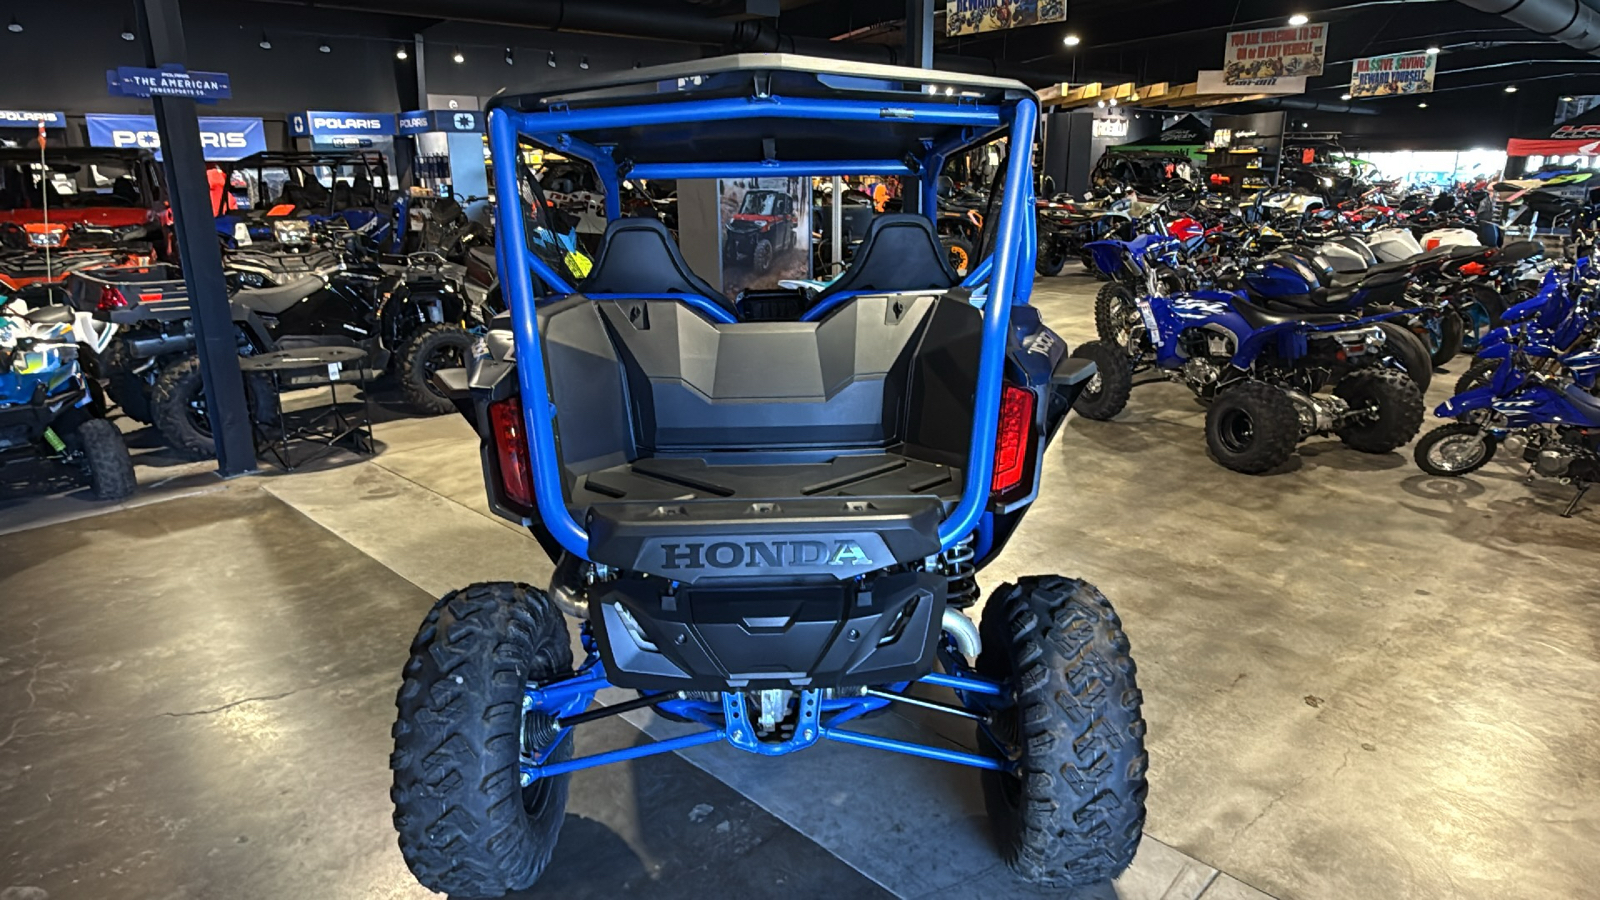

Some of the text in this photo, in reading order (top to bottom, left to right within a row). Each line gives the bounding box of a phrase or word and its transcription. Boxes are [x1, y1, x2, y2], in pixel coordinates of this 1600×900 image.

[1231, 26, 1323, 46] YOU ARE WELCOME TO SIT
[1237, 47, 1247, 60] ON
[1257, 46, 1265, 58] IN
[1266, 44, 1281, 57] ANY
[1283, 42, 1313, 56] VEHICLE
[133, 76, 219, 90] THE AMERICAN
[1360, 71, 1390, 85] REWARD
[1391, 69, 1426, 83] YOURSELF
[314, 117, 381, 129] POLARIS
[400, 117, 428, 128] POLARIS
[113, 130, 247, 148] PORIS
[661, 540, 873, 569] HONDA
